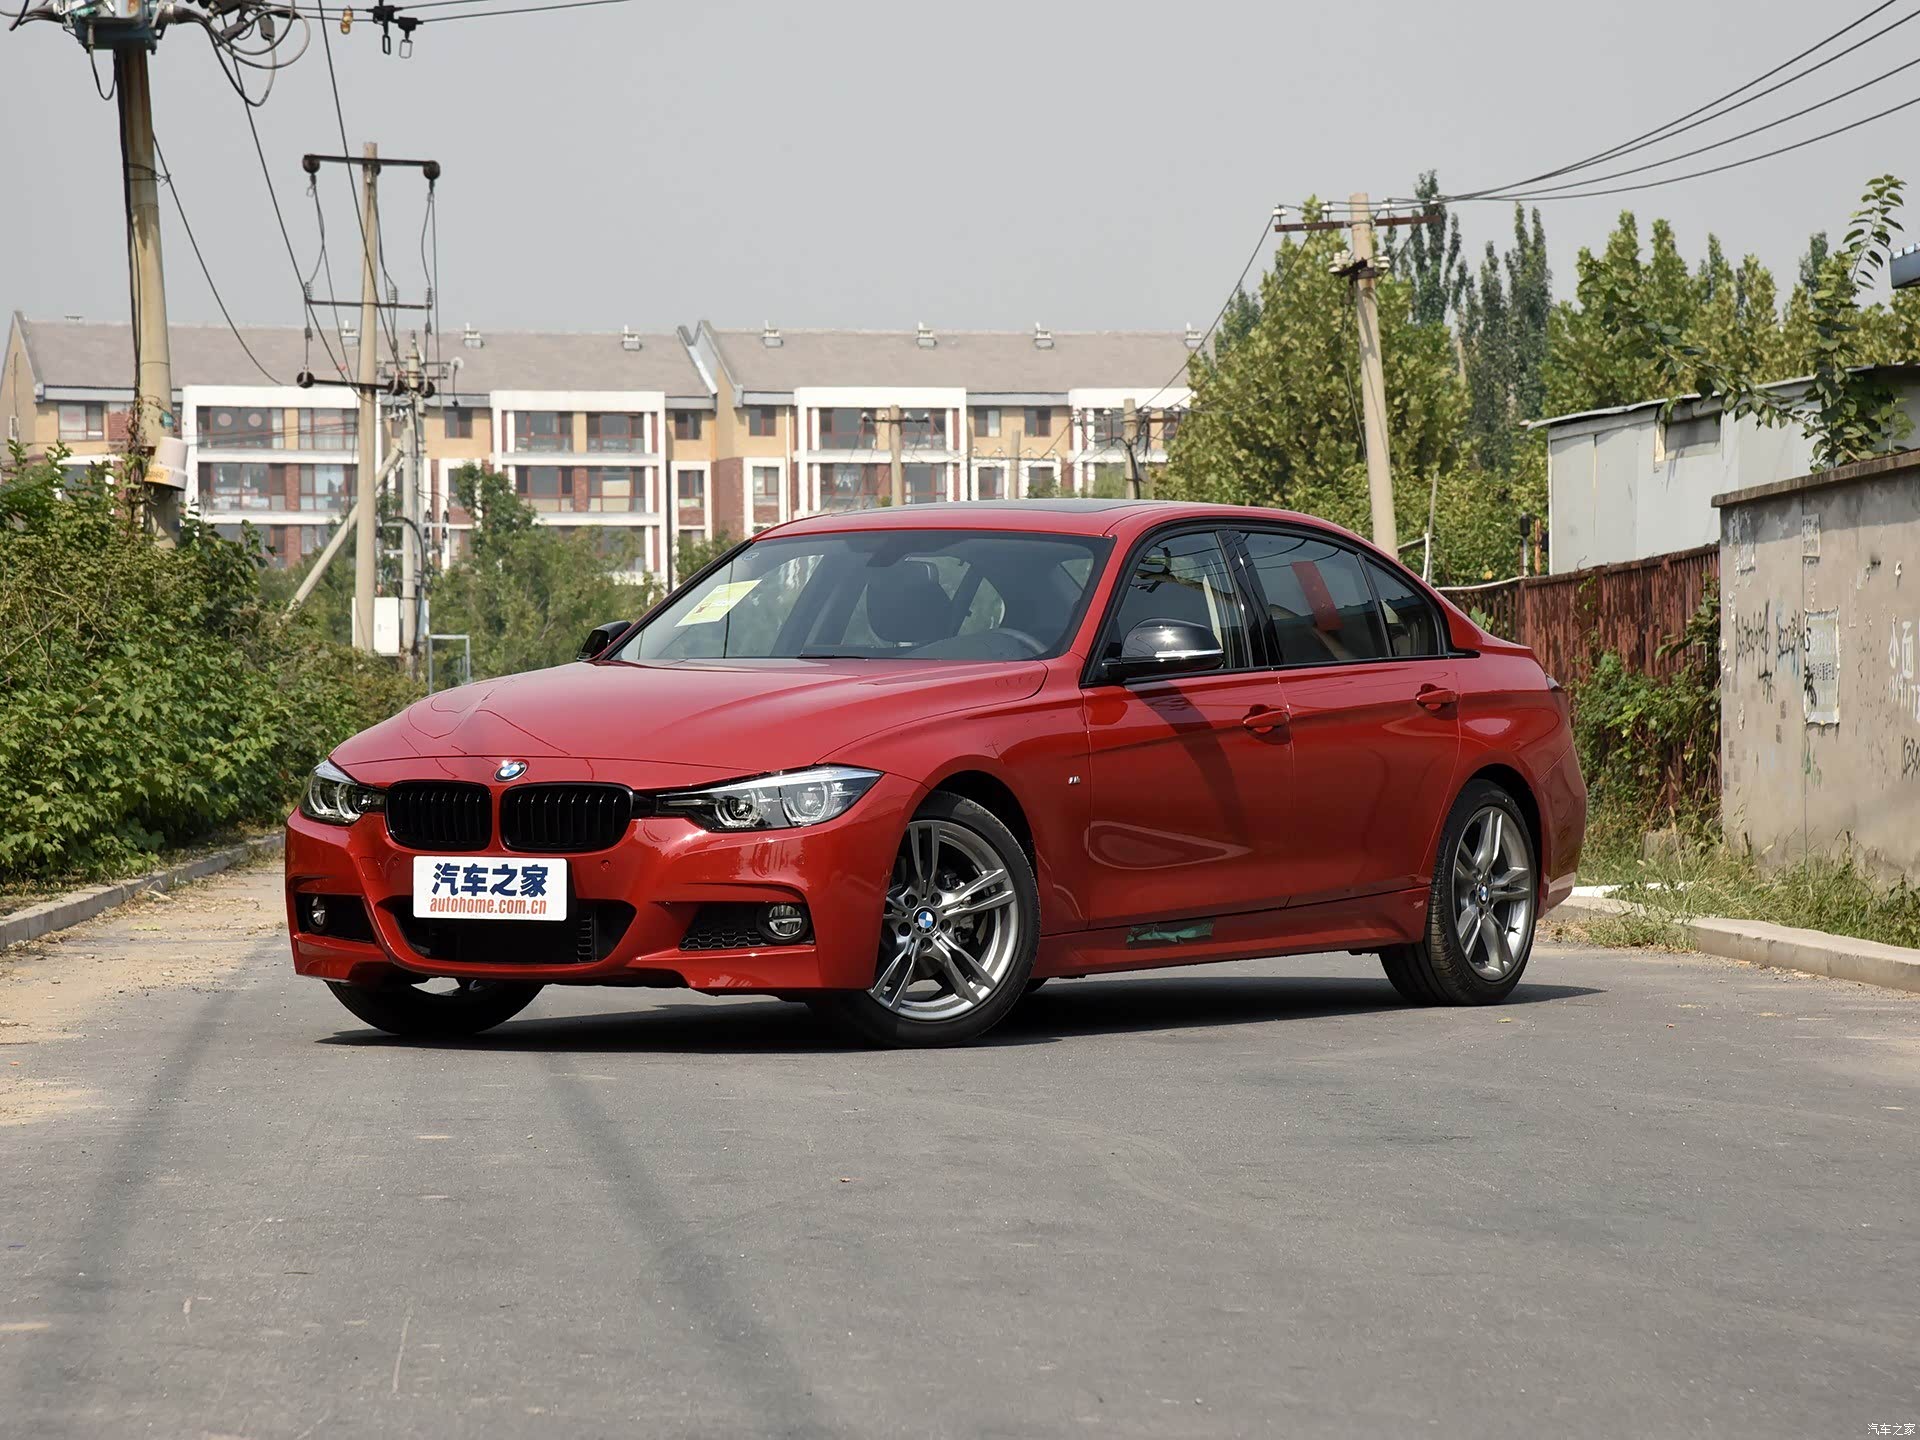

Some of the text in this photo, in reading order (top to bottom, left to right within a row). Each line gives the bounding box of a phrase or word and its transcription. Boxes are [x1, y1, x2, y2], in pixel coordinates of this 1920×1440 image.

[432, 863, 548, 897] 汽车之家
[430, 897, 547, 914] autohome.com.cn
